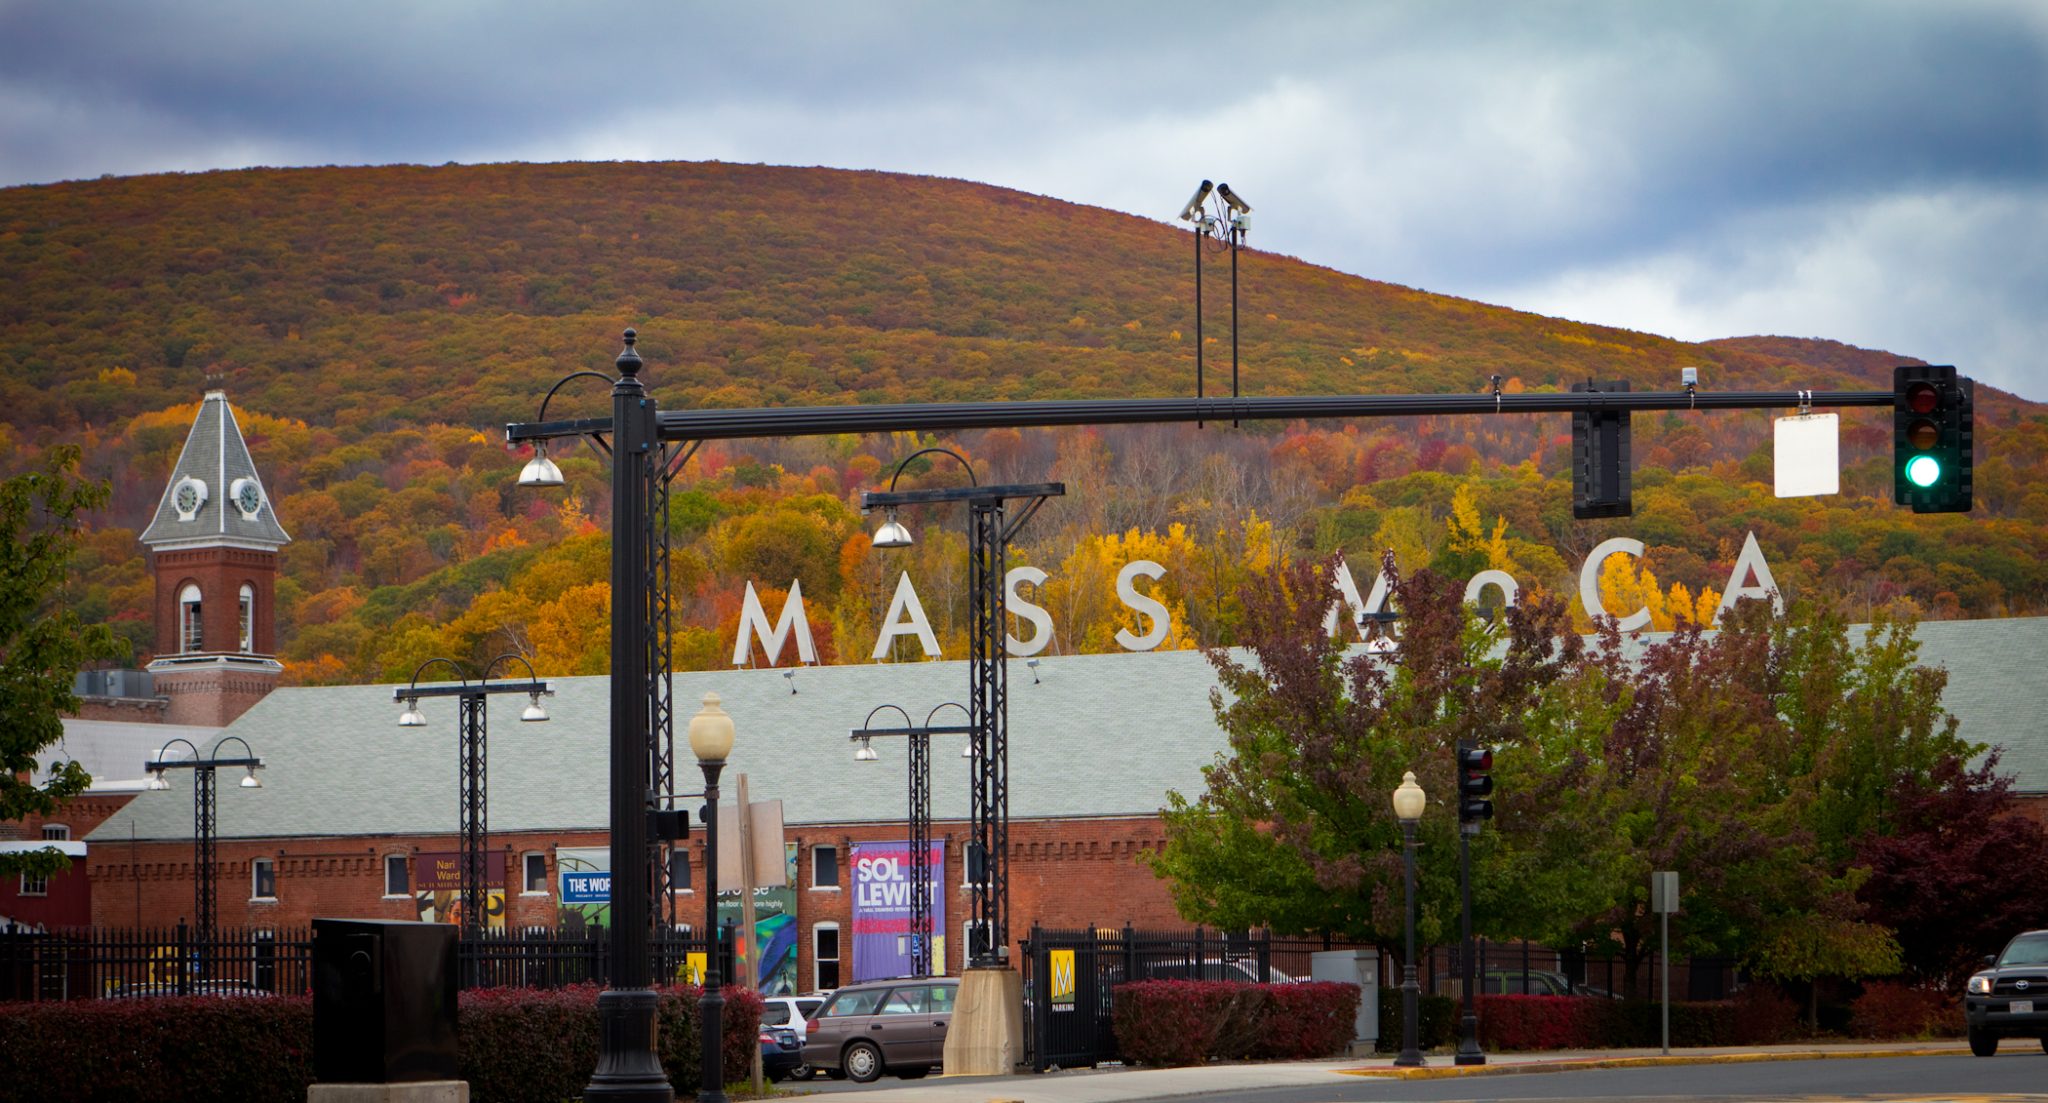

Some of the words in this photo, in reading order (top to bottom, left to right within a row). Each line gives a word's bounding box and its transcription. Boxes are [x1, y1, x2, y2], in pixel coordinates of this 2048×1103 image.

[732, 559, 1172, 668] MASS
[436, 860, 456, 870] Nari
[857, 857, 904, 882] SOL
[436, 871, 461, 881] Ward
[568, 878, 588, 893] THE
[589, 877, 611, 892] WOR
[766, 900, 783, 909] highly
[1054, 955, 1073, 998] M
[1052, 1003, 1075, 1012] PARKING
